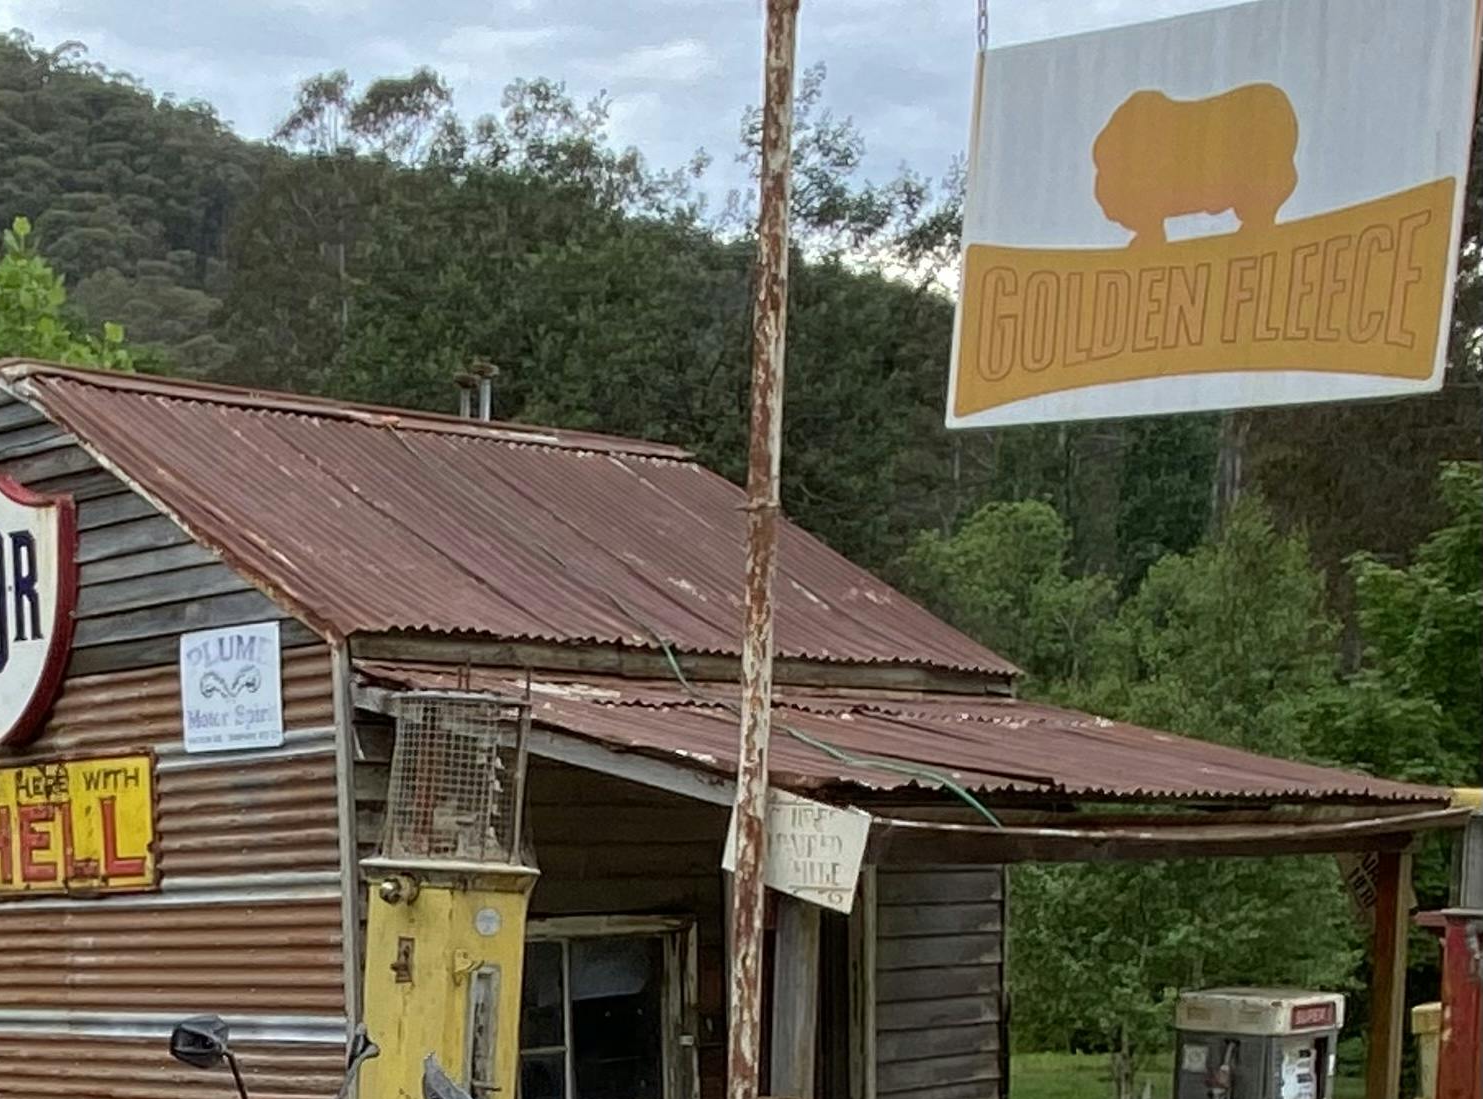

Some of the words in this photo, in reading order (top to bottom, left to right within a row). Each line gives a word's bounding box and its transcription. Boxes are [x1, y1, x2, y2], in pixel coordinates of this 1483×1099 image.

[976, 262, 1212, 382] GOLDEN
[1221, 209, 1432, 350] FLEECE
[234, 703, 276, 730] Spir
[17, 771, 68, 798] HERE
[82, 767, 140, 791] WITH
